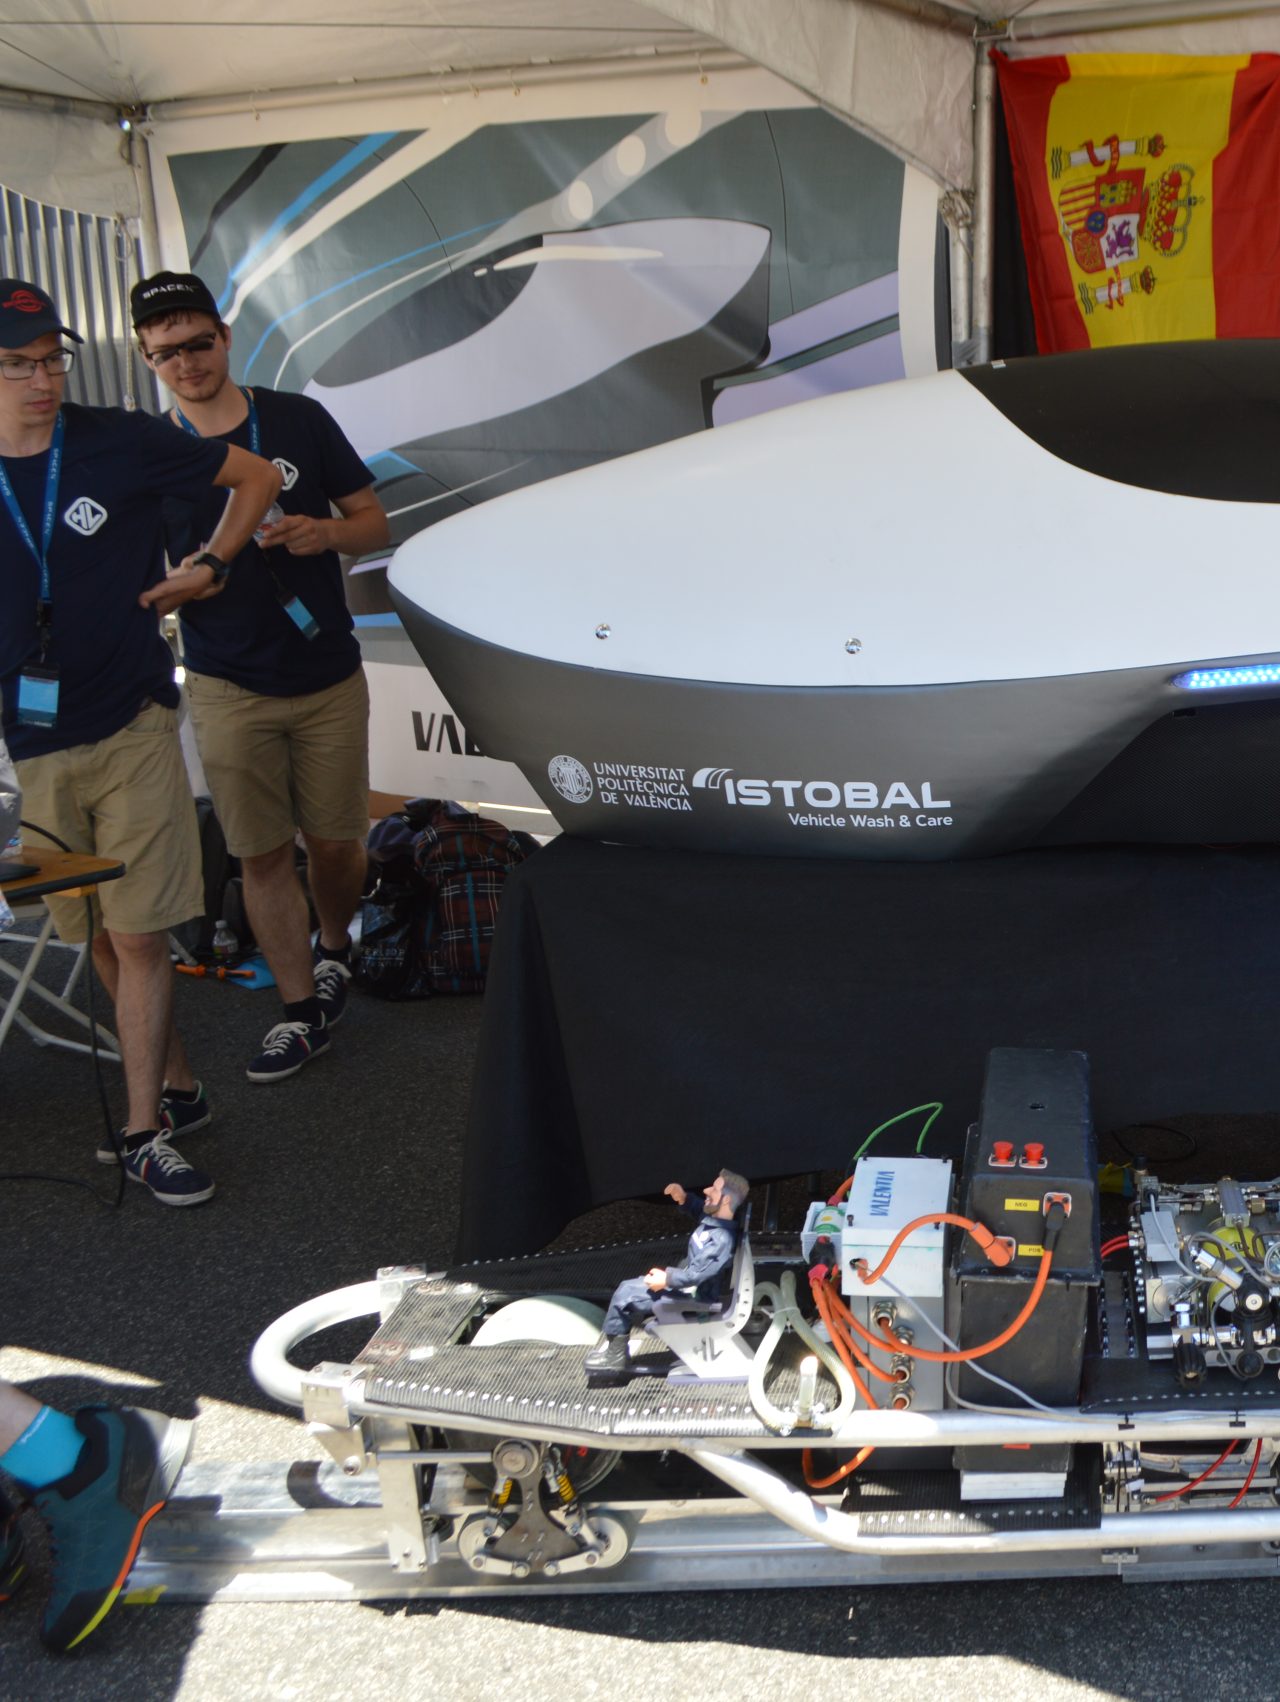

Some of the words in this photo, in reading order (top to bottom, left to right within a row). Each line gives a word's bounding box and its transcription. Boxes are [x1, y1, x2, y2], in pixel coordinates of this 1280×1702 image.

[594, 762, 685, 781] UNIVERSITAT
[596, 775, 690, 796] POLITÈCNICA
[724, 778, 951, 809] ISTOBAL
[600, 791, 619, 804] DE
[624, 793, 693, 811] VALÈNCIA
[788, 812, 846, 827] Vehicle
[850, 814, 894, 827] Wash
[899, 814, 911, 827] &
[915, 814, 953, 827] Care
[869, 1171, 895, 1217] VALENTIA
